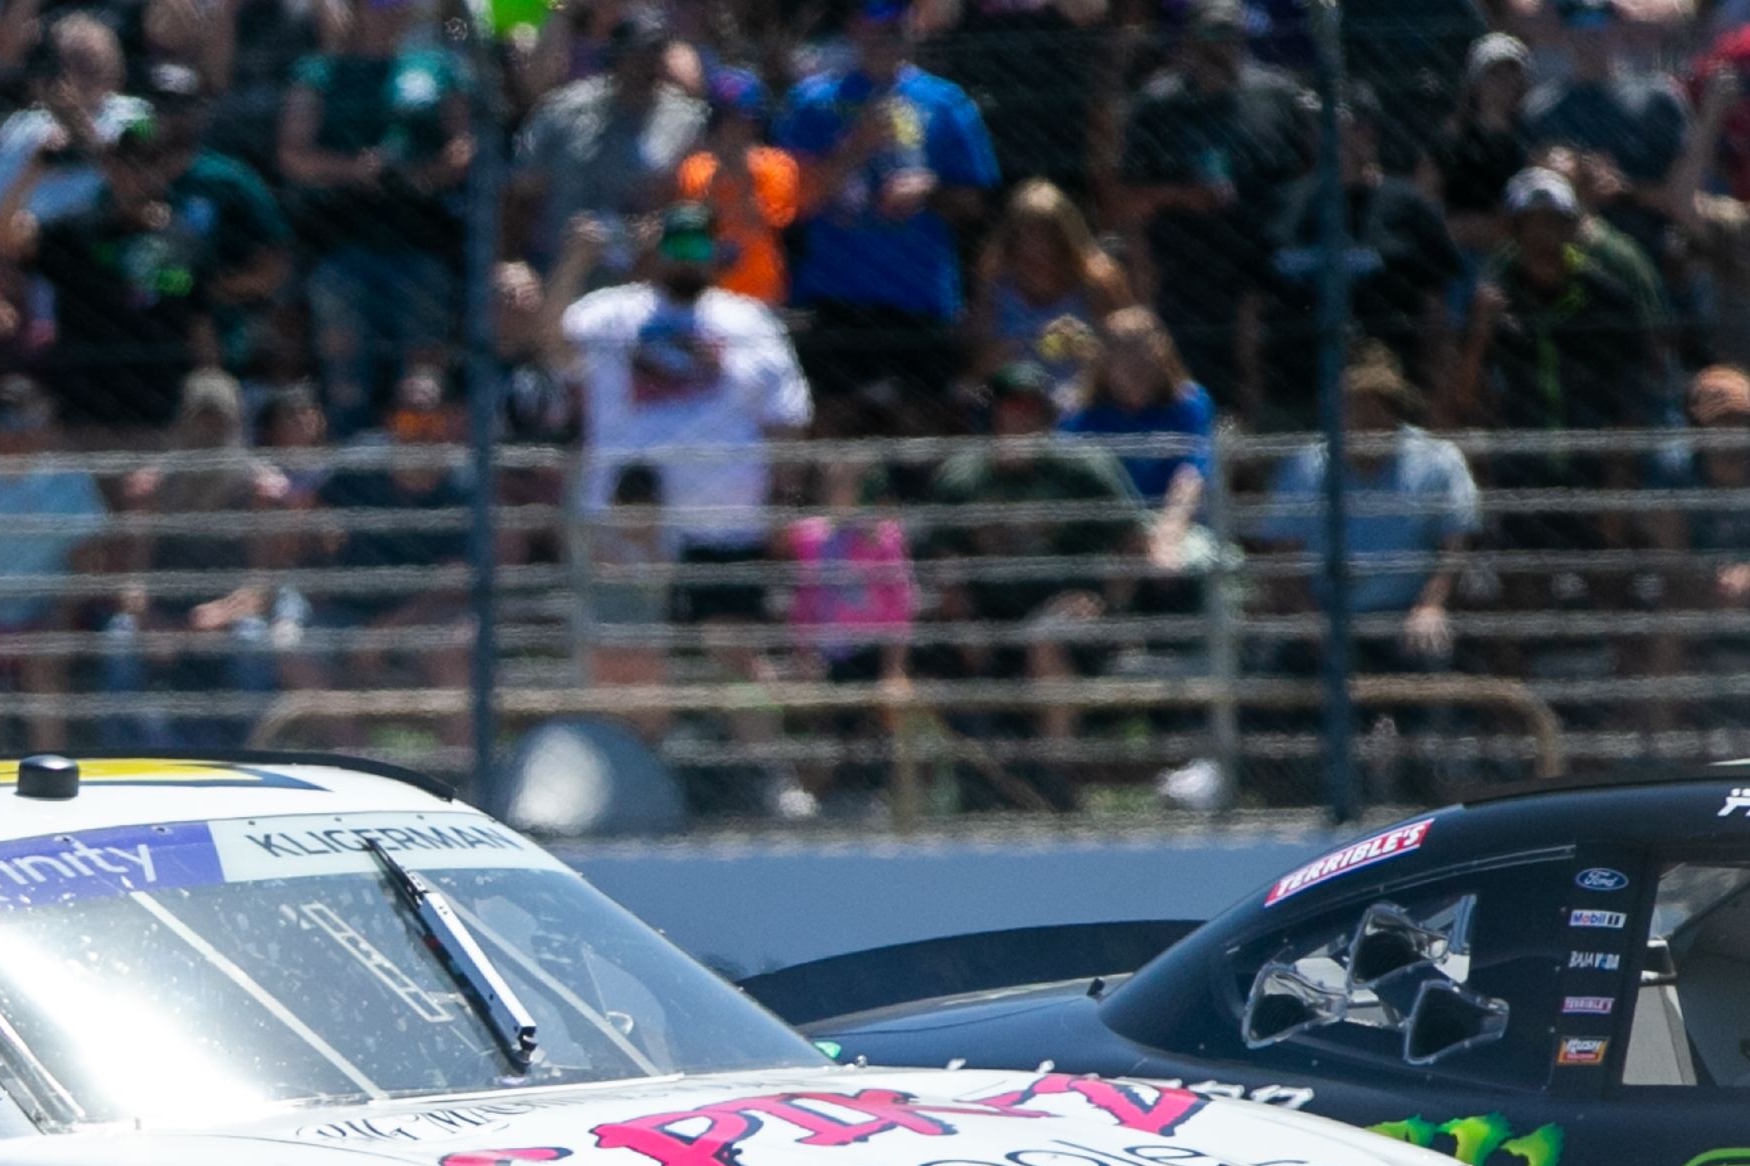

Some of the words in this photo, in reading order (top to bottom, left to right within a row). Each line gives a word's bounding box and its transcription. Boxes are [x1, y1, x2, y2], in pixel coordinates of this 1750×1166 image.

[245, 826, 525, 857] KLIGERMAN
[1276, 824, 1426, 897] TERRIBLE'S
[1584, 870, 1619, 887] Ford
[1573, 913, 1605, 924] Mobil
